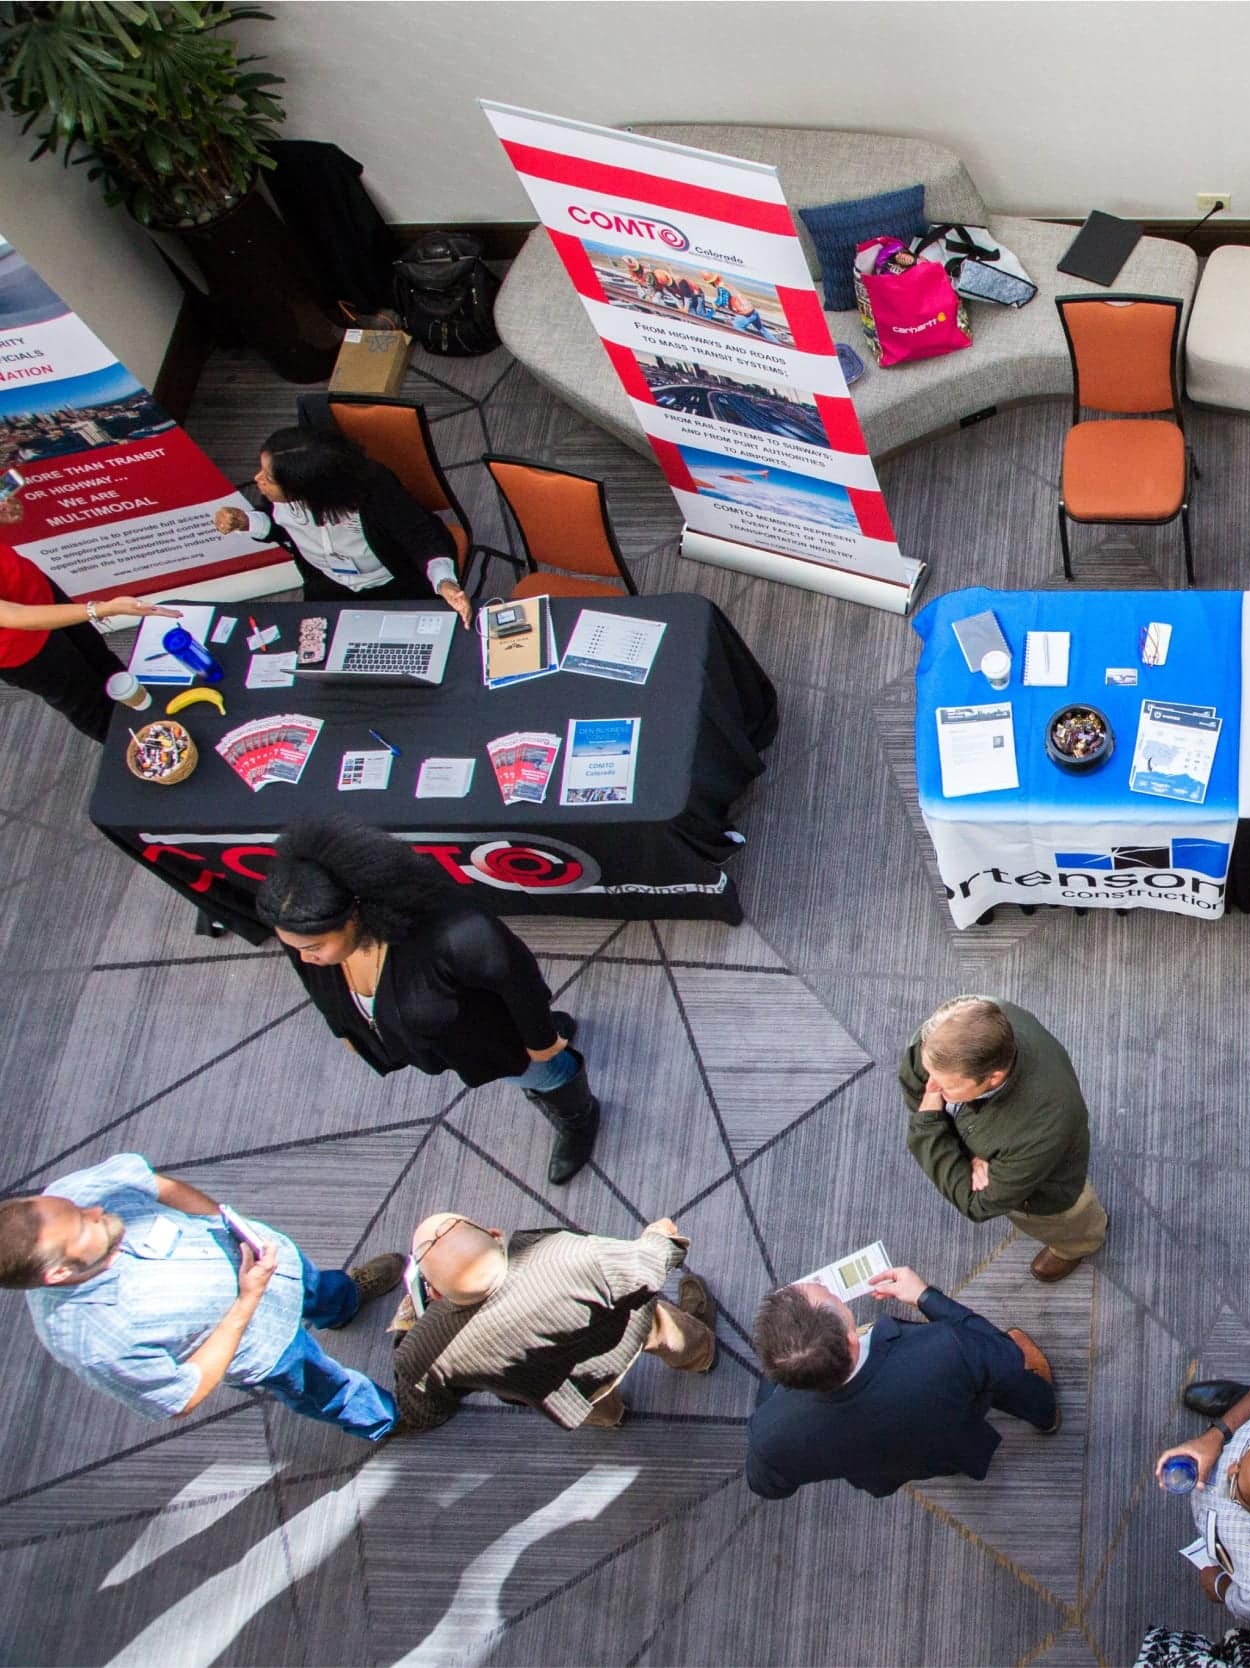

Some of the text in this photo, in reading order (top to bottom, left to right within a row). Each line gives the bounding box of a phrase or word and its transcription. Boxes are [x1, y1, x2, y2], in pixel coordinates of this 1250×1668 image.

[695, 246, 744, 264] Colorado
[0, 350, 44, 363] ICIALS
[634, 321, 787, 366] FROM HIGHWAYS AND ROADS
[642, 335, 657, 344] TO
[658, 339, 689, 351] MASS
[691, 346, 733, 362] TRANSIT
[664, 413, 692, 426] FROM
[694, 420, 716, 431] RAIL
[719, 426, 765, 442] SYSTEMS
[767, 438, 780, 446] TO
[681, 427, 826, 468] AND FROM PORT AUTHORITIES
[724, 446, 737, 455] TO
[24, 448, 166, 486] MORE THAN TRANSIT
[24, 490, 48, 501] OR
[49, 475, 113, 496] HIGHWAY
[57, 489, 120, 510] WE ARE
[44, 496, 159, 528] MULTIMODAL
[713, 503, 857, 544] COMTO MEMBERS REPRESENT
[40, 546, 59, 556] Our
[61, 538, 98, 551] mission
[122, 525, 158, 537] provide
[160, 520, 176, 528] full
[177, 513, 211, 524] access
[125, 534, 154, 545] career
[156, 528, 174, 538] and
[728, 523, 807, 547] TRANSPORTATION
[741, 518, 837, 547] EVERY FACET OF THE
[50, 551, 112, 571] opportunities
[113, 547, 127, 556] for
[129, 538, 176, 553] minorities
[178, 532, 196, 541] and
[70, 563, 99, 575] within
[101, 559, 116, 568] the
[117, 544, 183, 565] transportation
